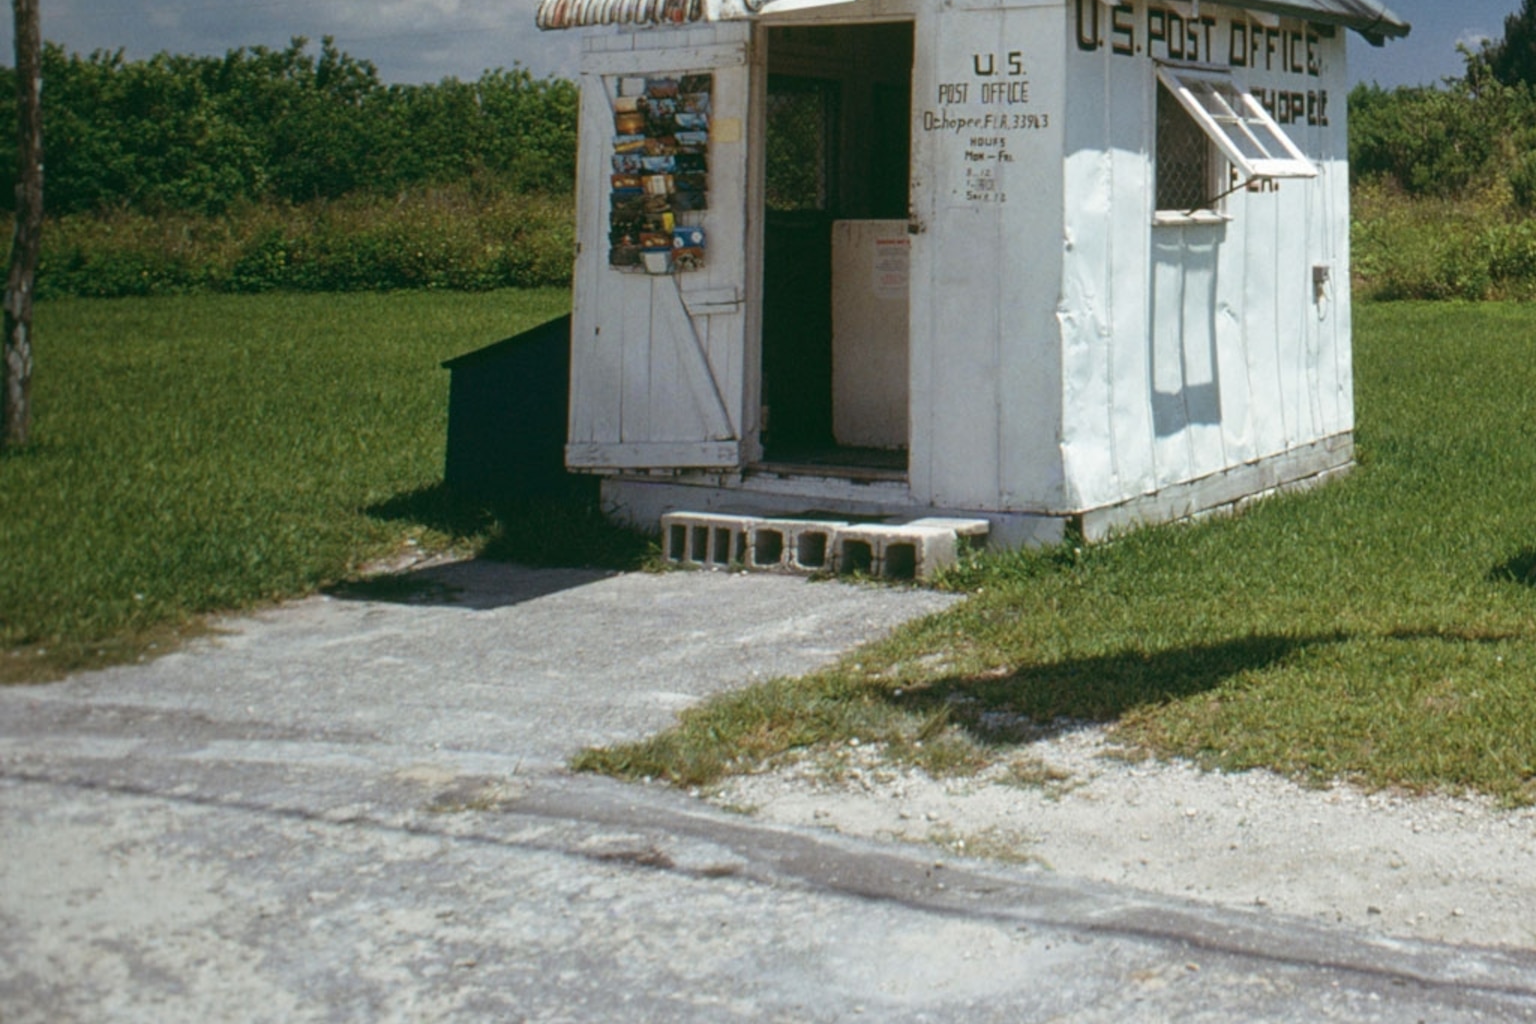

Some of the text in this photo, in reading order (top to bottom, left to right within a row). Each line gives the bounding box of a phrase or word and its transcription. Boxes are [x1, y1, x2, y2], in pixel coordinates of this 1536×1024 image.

[1147, 6, 1217, 63] POST
[938, 80, 1028, 105] POST OFFICE
